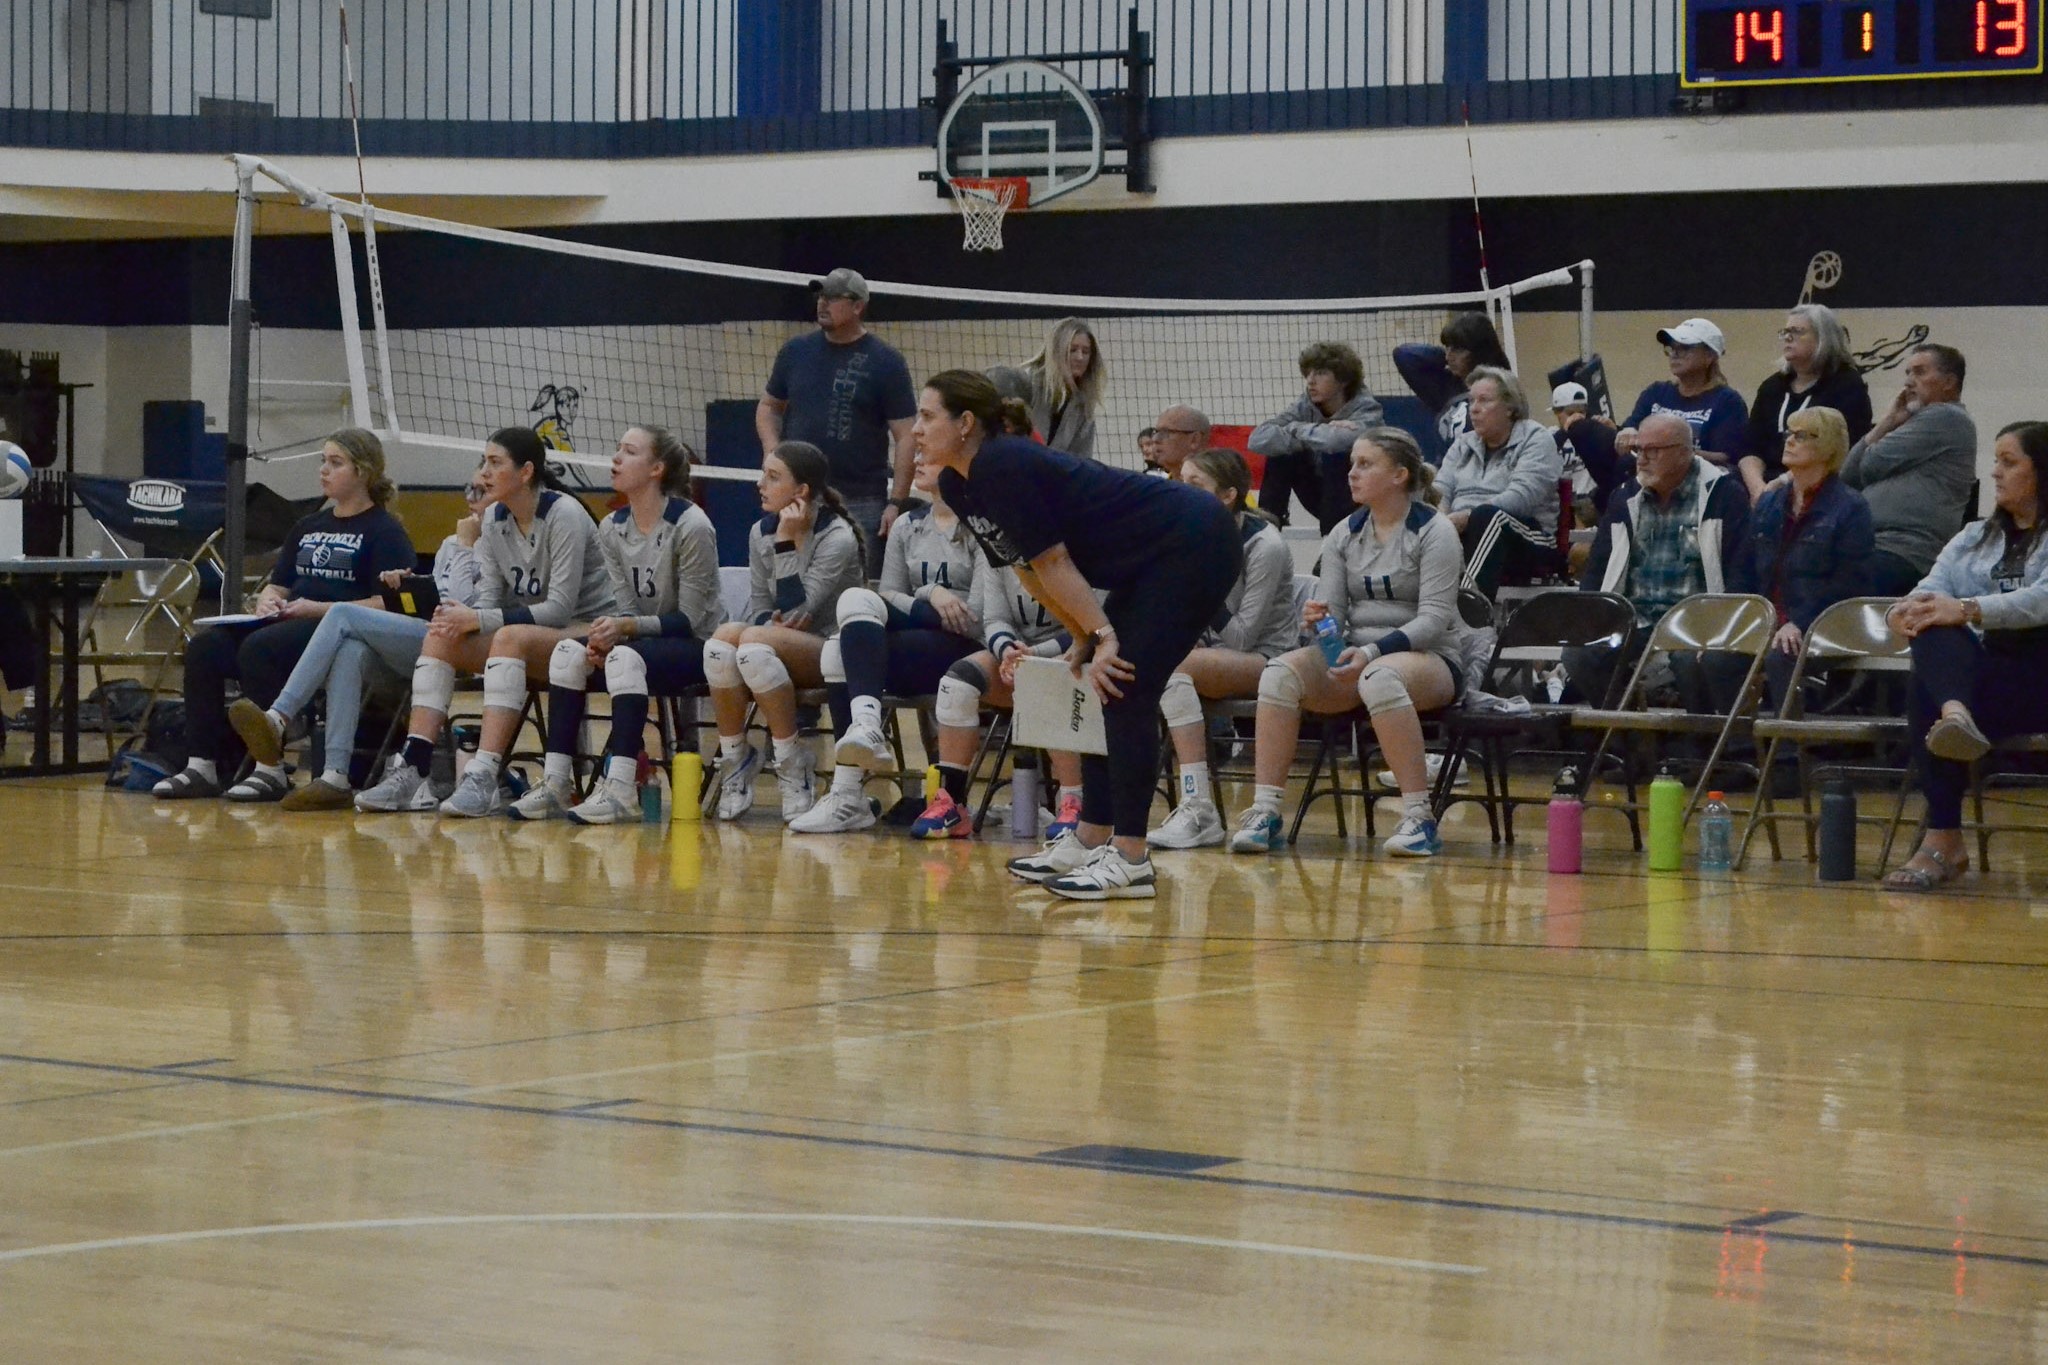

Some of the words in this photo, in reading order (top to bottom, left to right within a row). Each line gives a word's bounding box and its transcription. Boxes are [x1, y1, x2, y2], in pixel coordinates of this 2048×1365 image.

[1735, 10, 1783, 63] 14
[1861, 12, 1873, 51] 1
[1976, 0, 2026, 56] 13
[129, 483, 182, 506] TACHIKARA
[299, 532, 363, 549] SENTINELS
[510, 566, 541, 597] 26
[632, 567, 656, 598] 13
[921, 562, 952, 589] 14
[1364, 575, 1395, 600] 11
[1071, 688, 1086, 732] Baden
